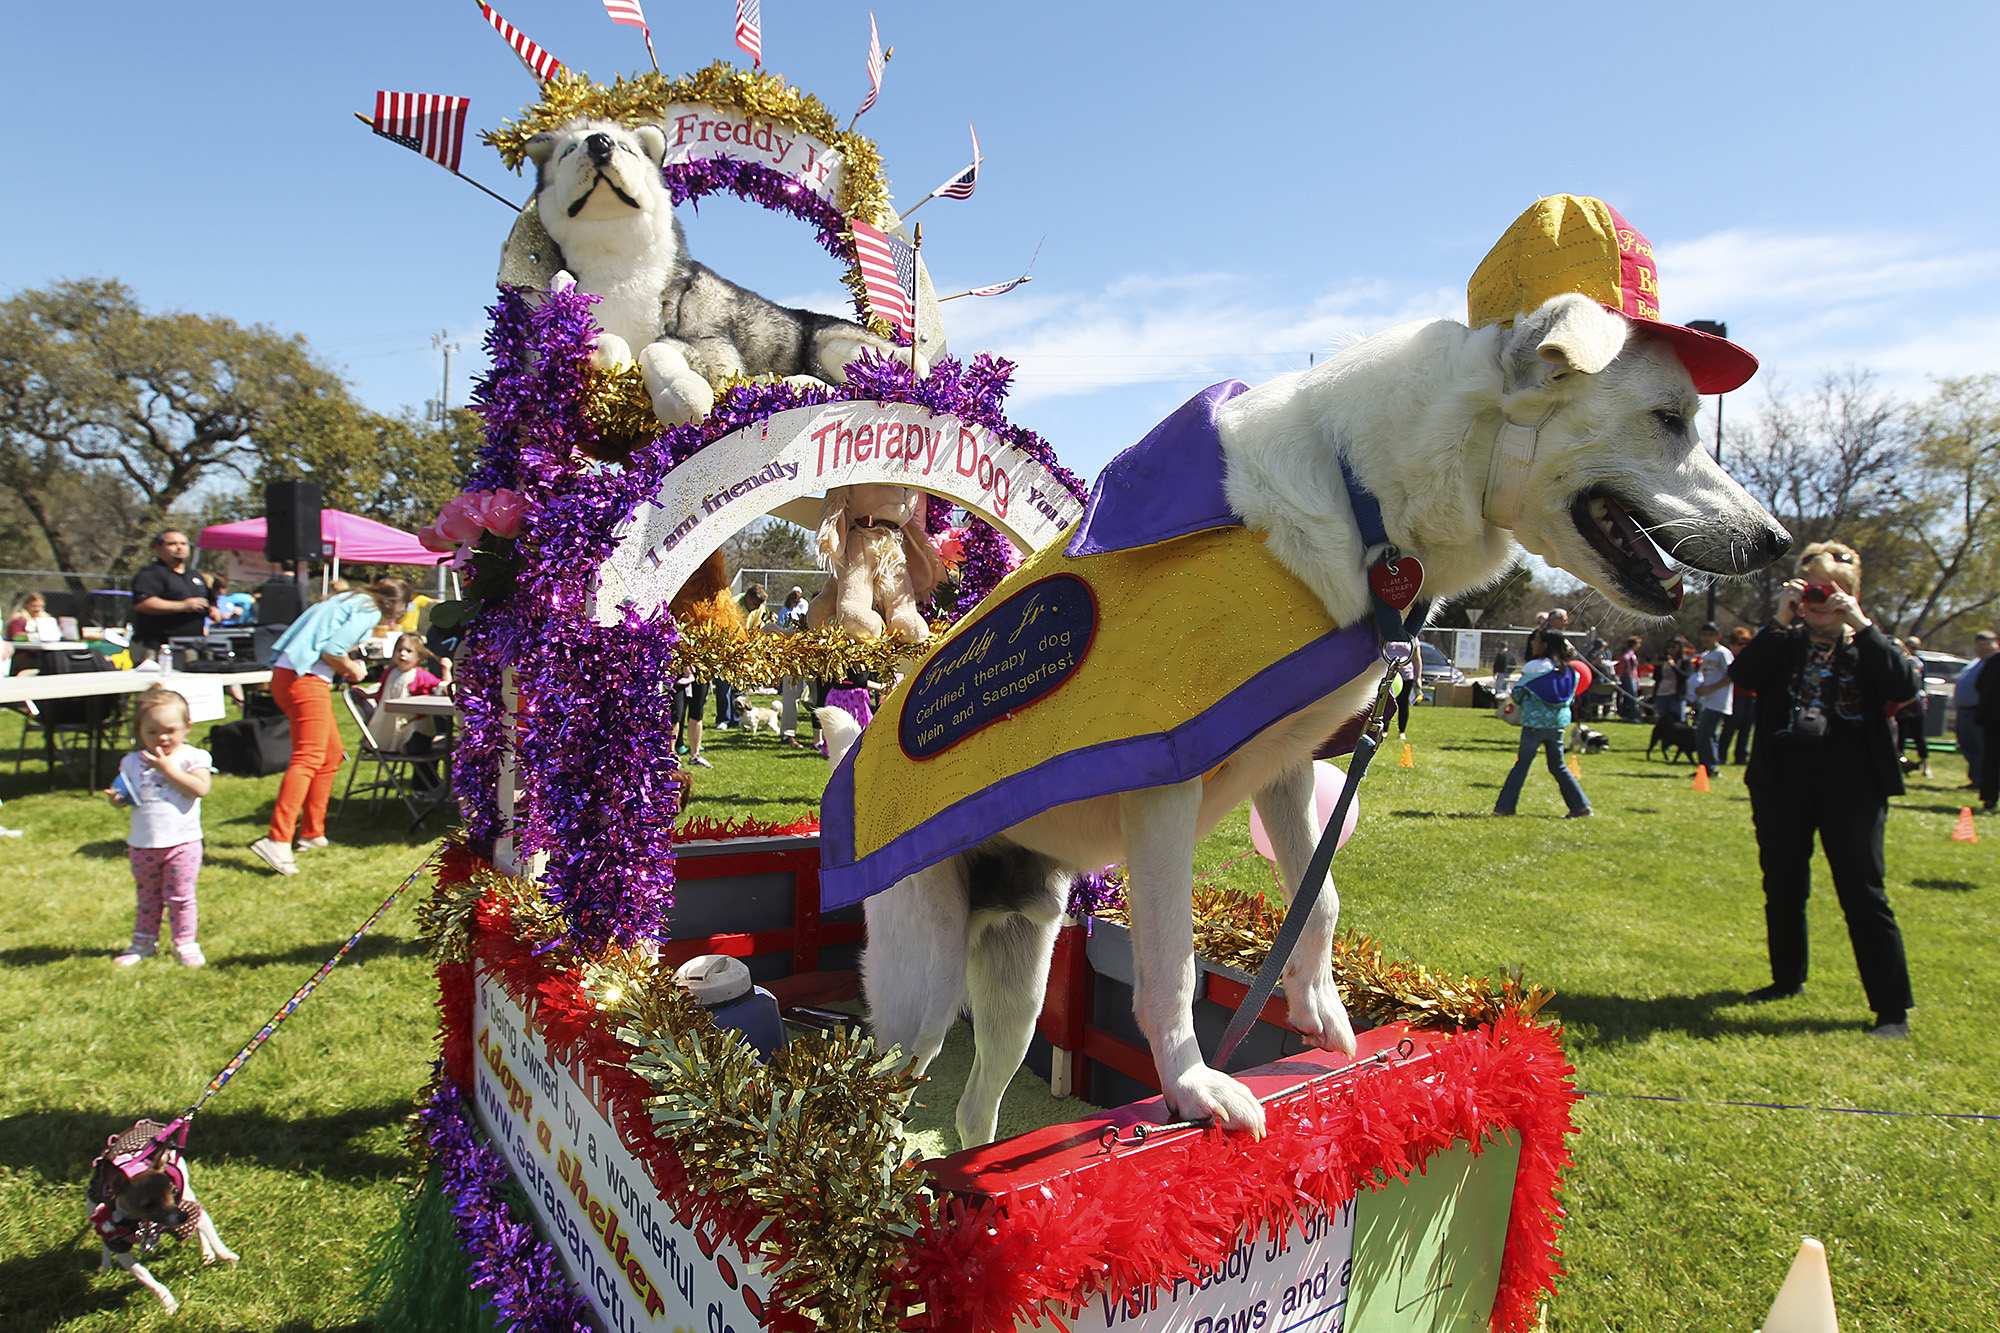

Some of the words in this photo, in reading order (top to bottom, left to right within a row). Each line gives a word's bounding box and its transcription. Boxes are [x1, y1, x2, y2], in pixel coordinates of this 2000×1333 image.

[672, 112, 794, 165] Freddy
[801, 142, 836, 196] Jr.
[645, 547, 663, 569] I
[661, 512, 700, 552] am
[701, 459, 801, 520] friendly
[810, 419, 942, 478] Therapy
[956, 425, 1011, 520] Dog
[1025, 486, 1059, 522] You
[1381, 583, 1414, 595] THERAPY
[1391, 592, 1406, 601] DOG
[915, 682, 966, 724] Certified
[973, 649, 1027, 687] therapy
[1038, 630, 1072, 652] dog
[918, 627, 999, 696] Freddy
[1008, 592, 1059, 644] Jr.
[917, 723, 944, 748] Wein
[952, 701, 975, 726] and
[982, 651, 1075, 707] Saengerfest
[476, 1025, 534, 1125] Adopt
[536, 1118, 552, 1154] a
[556, 1149, 666, 1318] shelter
[490, 993, 517, 1058] being
[521, 1040, 560, 1112] owned
[564, 1090, 581, 1147] by
[587, 1132, 599, 1168] a
[605, 1153, 695, 1311] wonderful
[1304, 1213, 1329, 1245] on
[1194, 1299, 1267, 1333] Paws
[1281, 1261, 1329, 1316] and
